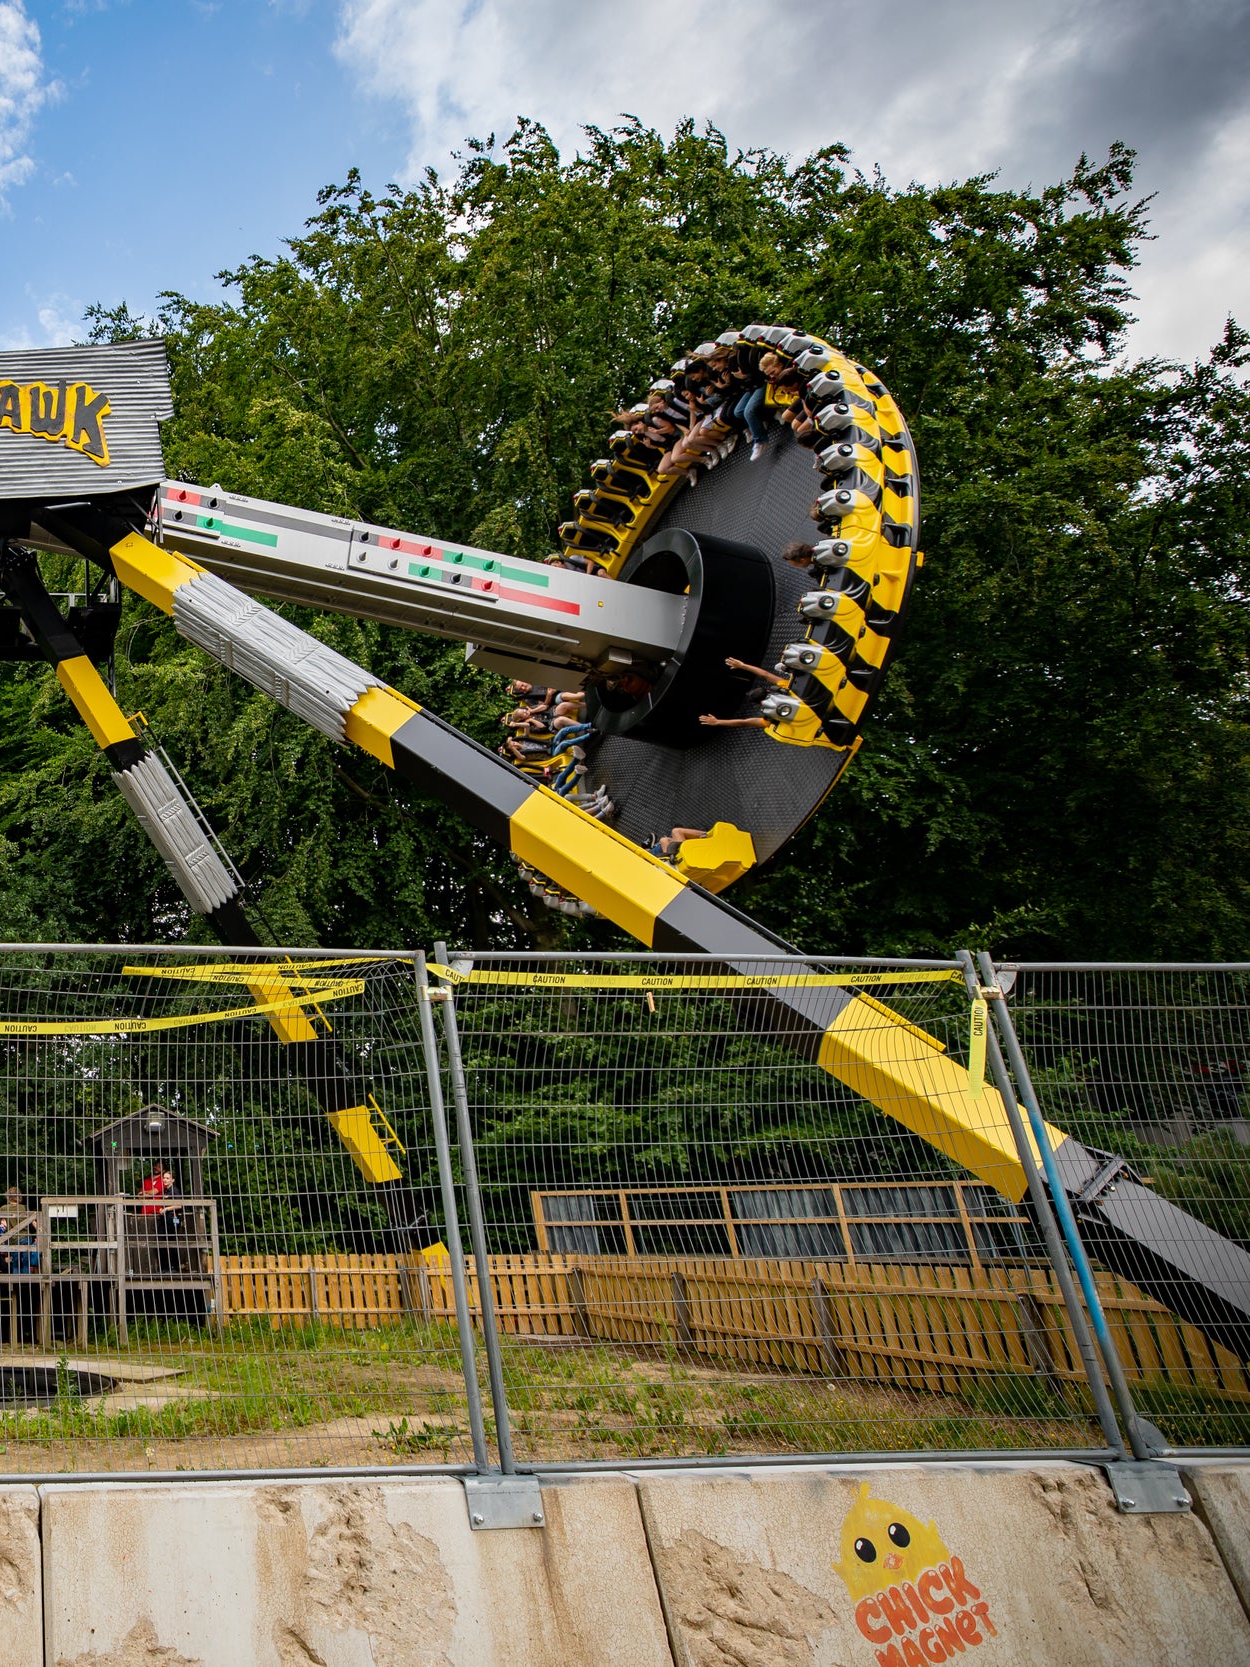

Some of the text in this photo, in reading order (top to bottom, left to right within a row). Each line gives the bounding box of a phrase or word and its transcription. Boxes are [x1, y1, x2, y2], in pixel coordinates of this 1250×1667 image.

[445, 969, 465, 982] CAUT
[533, 975, 566, 984] CAUTION
[851, 975, 881, 983] CAUTION
[642, 977, 673, 986] CAUTION
[747, 977, 778, 986] CAUTION
[333, 984, 363, 997] CAUTION
[224, 1008, 257, 1018] CAUTION
[114, 1021, 147, 1030] CAUTION
[855, 1556, 980, 1644] CHICK
